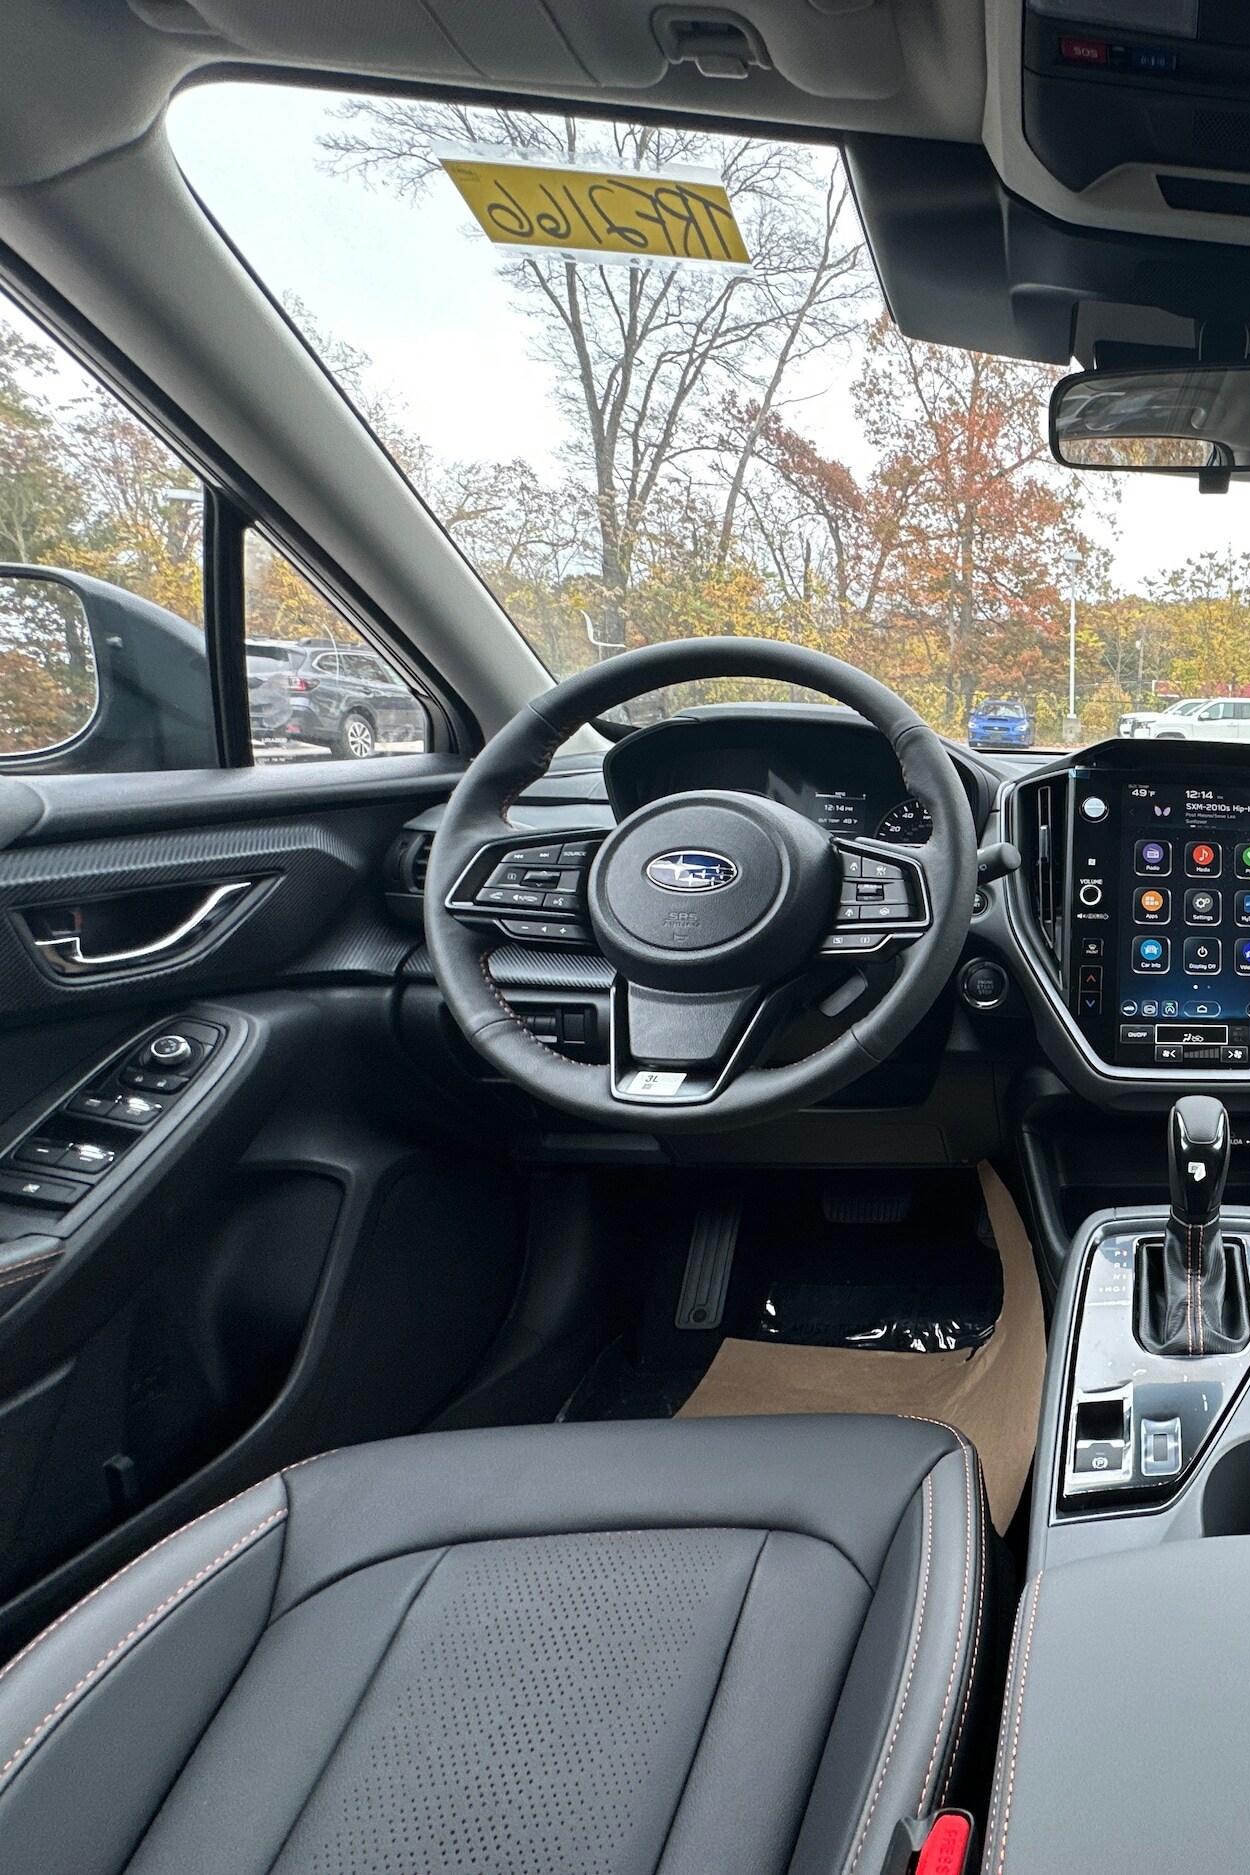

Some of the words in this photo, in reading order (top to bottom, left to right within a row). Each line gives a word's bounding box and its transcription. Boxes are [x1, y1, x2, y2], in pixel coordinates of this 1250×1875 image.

[1073, 46, 1098, 58] SOS
[1185, 790, 1213, 799] 12:14
[1185, 803, 1231, 812] SXM-2010s
[669, 912, 698, 920] SRS
[1192, 914, 1214, 922] Settings
